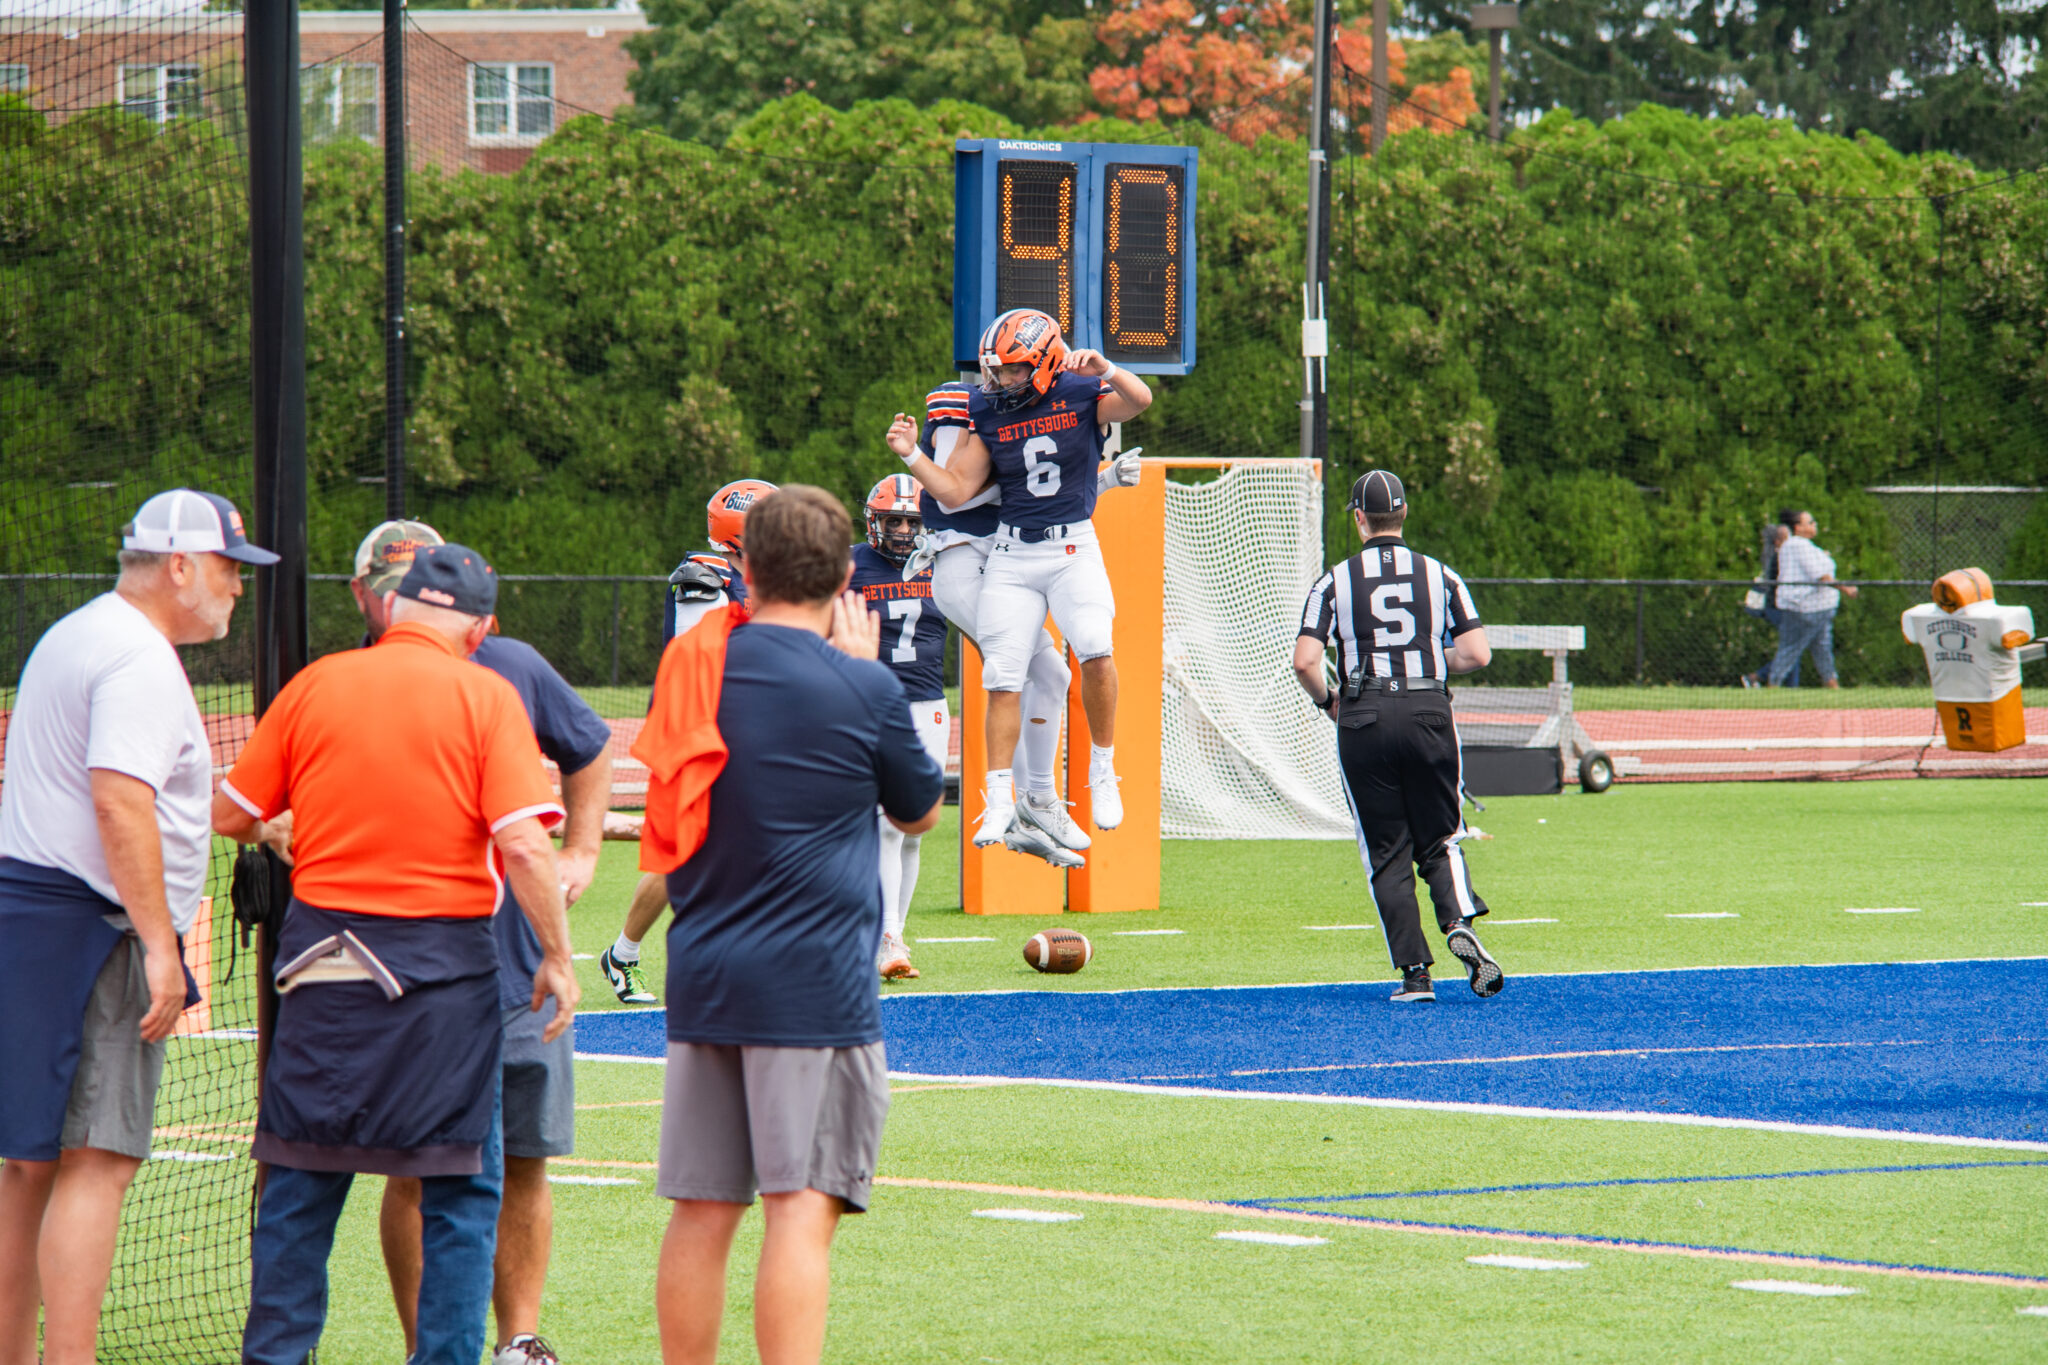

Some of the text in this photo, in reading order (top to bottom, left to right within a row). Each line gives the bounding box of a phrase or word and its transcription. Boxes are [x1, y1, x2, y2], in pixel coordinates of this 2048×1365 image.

[999, 140, 1062, 151] DAKTRONICS
[997, 411, 1078, 442] GETTYSBURG
[1023, 435, 1061, 497] 6
[725, 491, 754, 512] Bull
[1065, 544, 1077, 555] G
[1382, 551, 1392, 560] S
[862, 581, 934, 601] GETTYSBUR
[1370, 582, 1416, 647] S
[888, 598, 922, 663] 7
[1926, 619, 1977, 639] GETTYSBURG
[1935, 651, 1974, 664] COLLEGE
[1390, 680, 1399, 691] S
[934, 711, 942, 725] G
[1955, 706, 1972, 731] R
